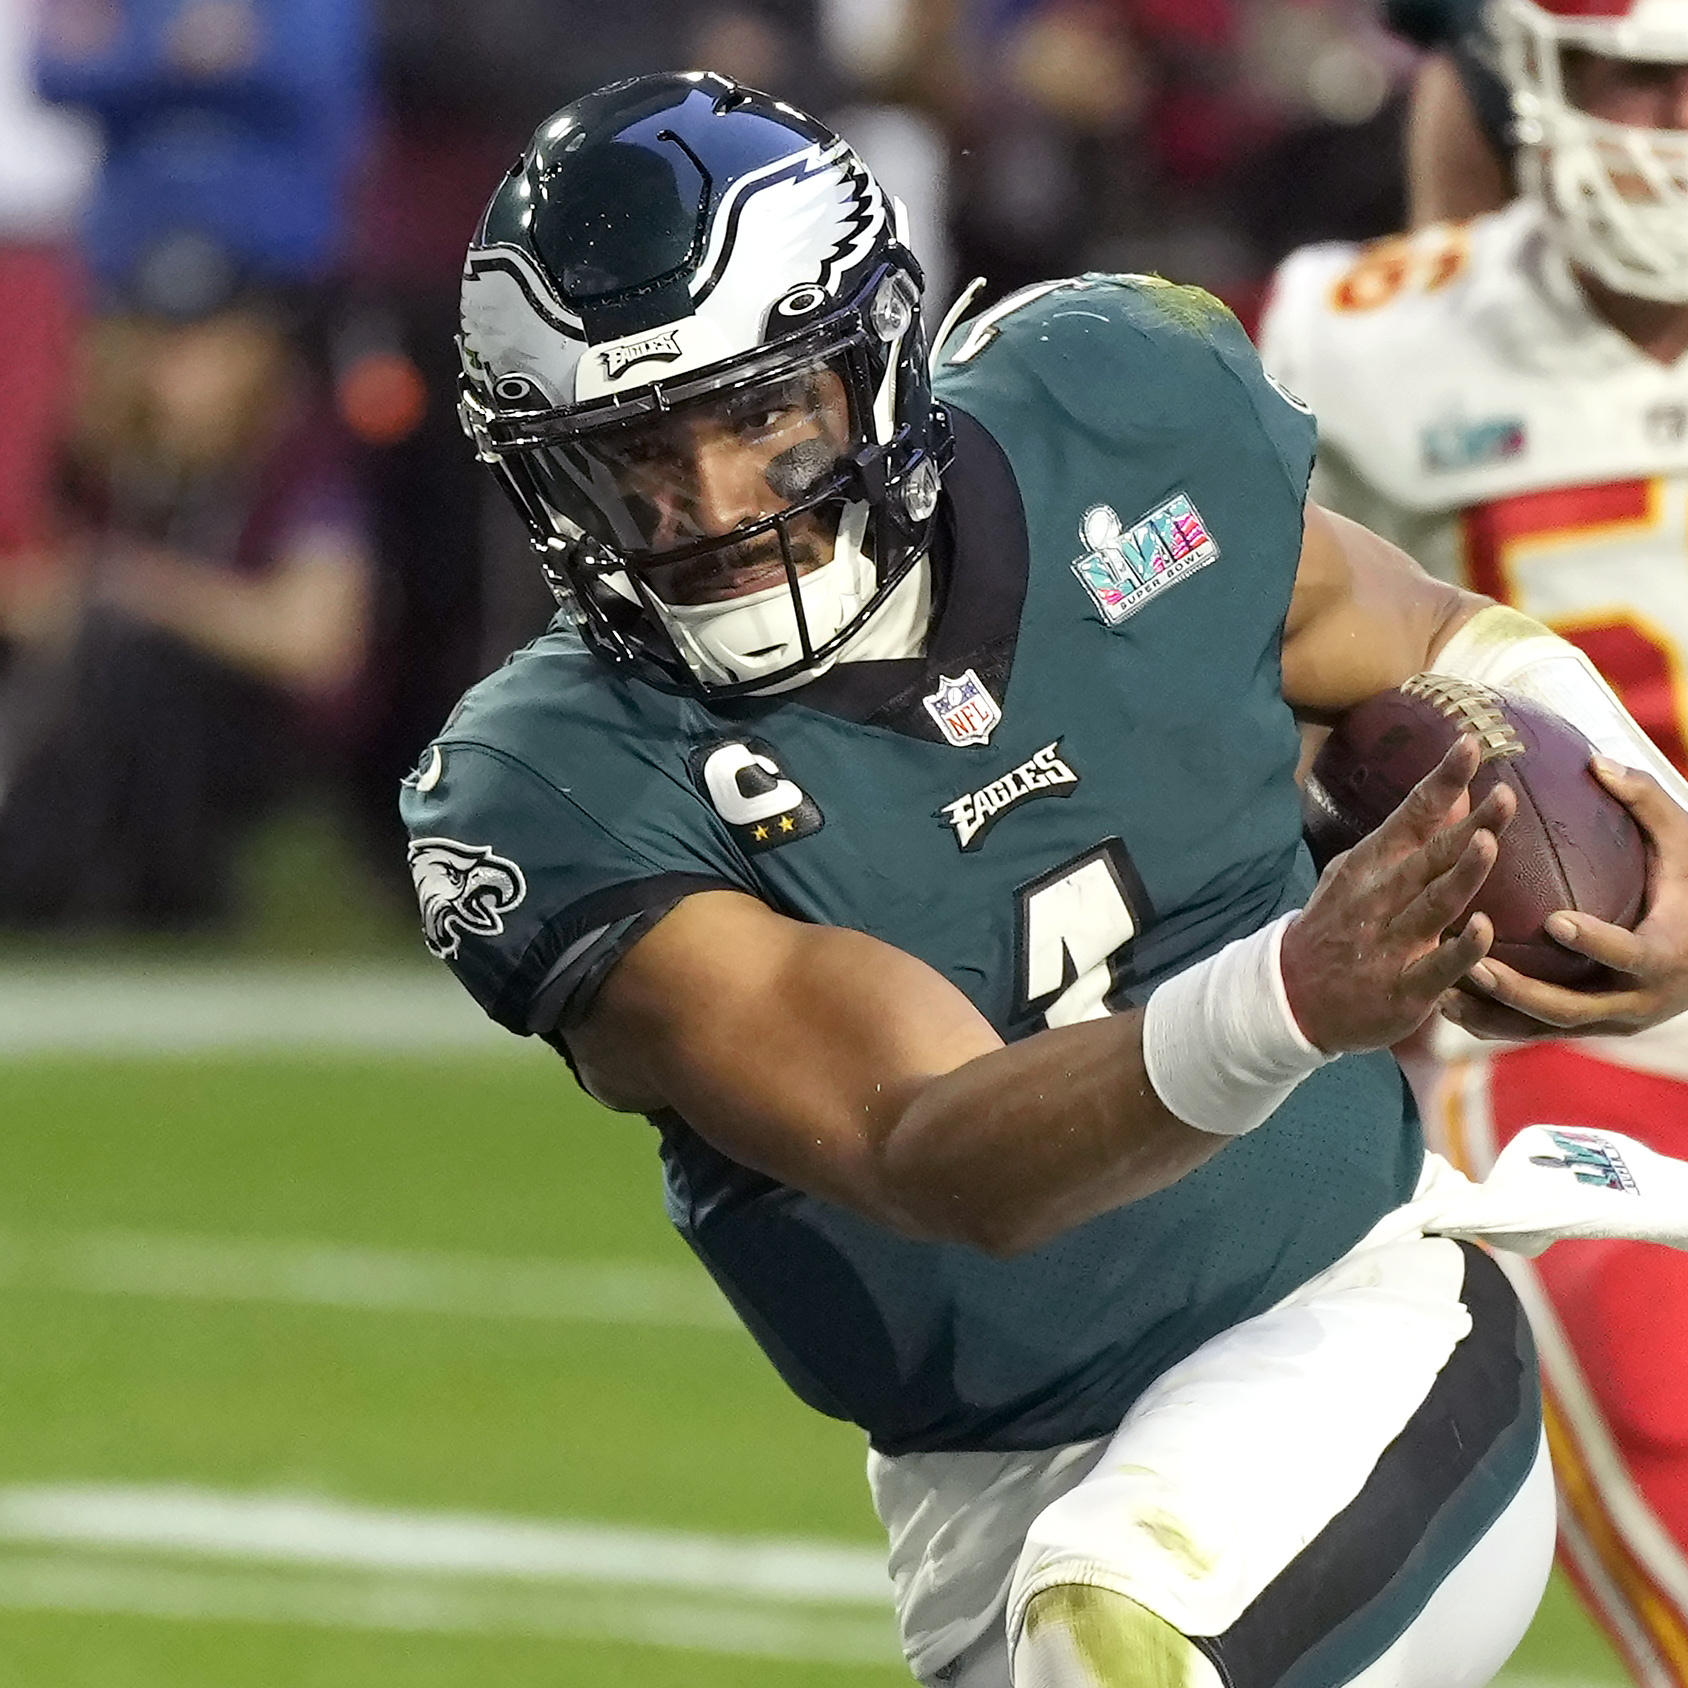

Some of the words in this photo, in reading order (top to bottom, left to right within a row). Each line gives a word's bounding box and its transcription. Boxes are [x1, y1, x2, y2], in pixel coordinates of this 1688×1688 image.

[1119, 578, 1162, 611] SUPER
[1165, 549, 1205, 579] BOWL
[946, 701, 990, 737] NFL
[703, 743, 804, 826] C
[939, 741, 1079, 848] EAGLES
